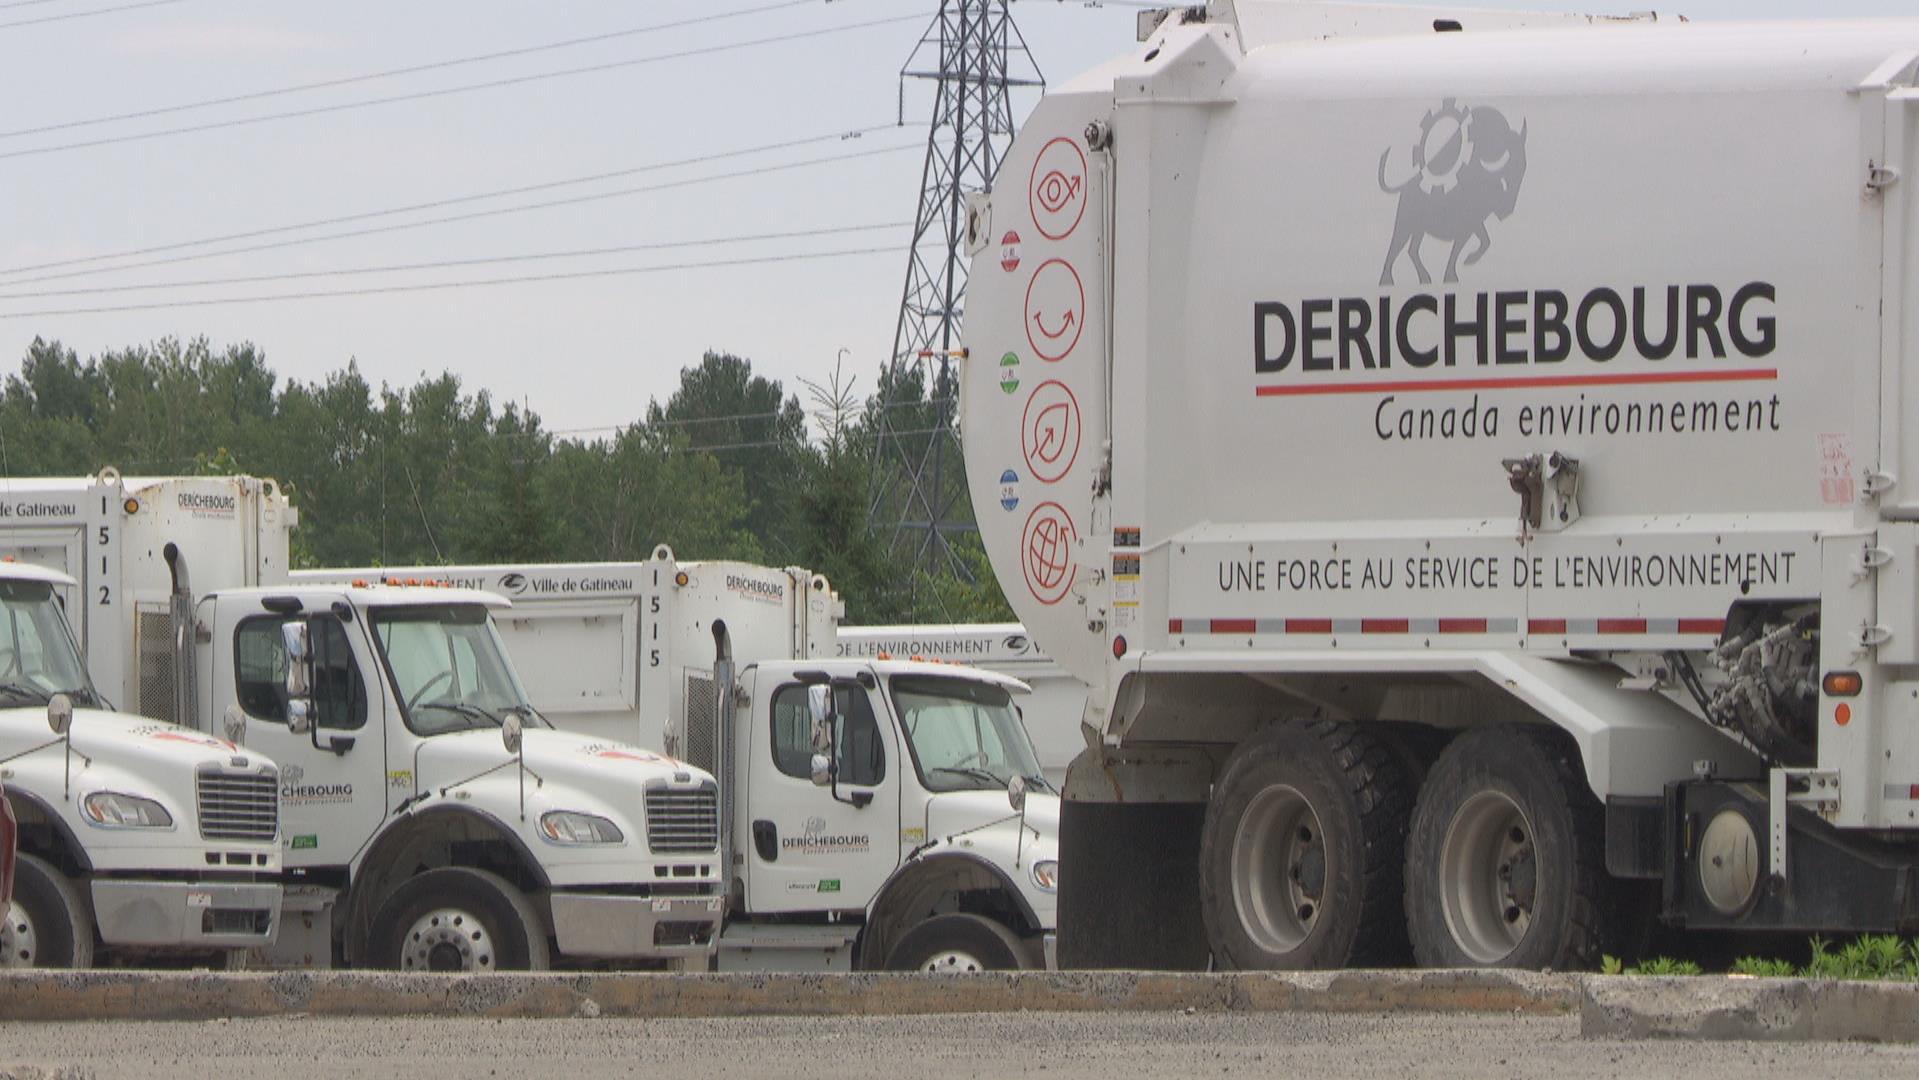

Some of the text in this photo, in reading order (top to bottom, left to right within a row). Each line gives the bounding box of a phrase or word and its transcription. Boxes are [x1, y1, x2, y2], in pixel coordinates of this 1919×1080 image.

[1254, 281, 1776, 374] DERICHEBOURG
[1375, 393, 1780, 440] Canada environnement
[178, 492, 235, 509] DERICHEBOURG
[16, 502, 76, 517] Gatineau
[1219, 551, 1796, 591] UNE FORCE AU SERVICE DE L'ENVIRONNEMENT
[532, 577, 633, 592] Ville de Gatineau
[726, 575, 783, 597] DERICHEBOURG
[859, 639, 993, 656] L'ENVIRONNEMENT
[282, 784, 352, 797] CHEBOURG
[782, 835, 869, 848] DERICHEBOURG
